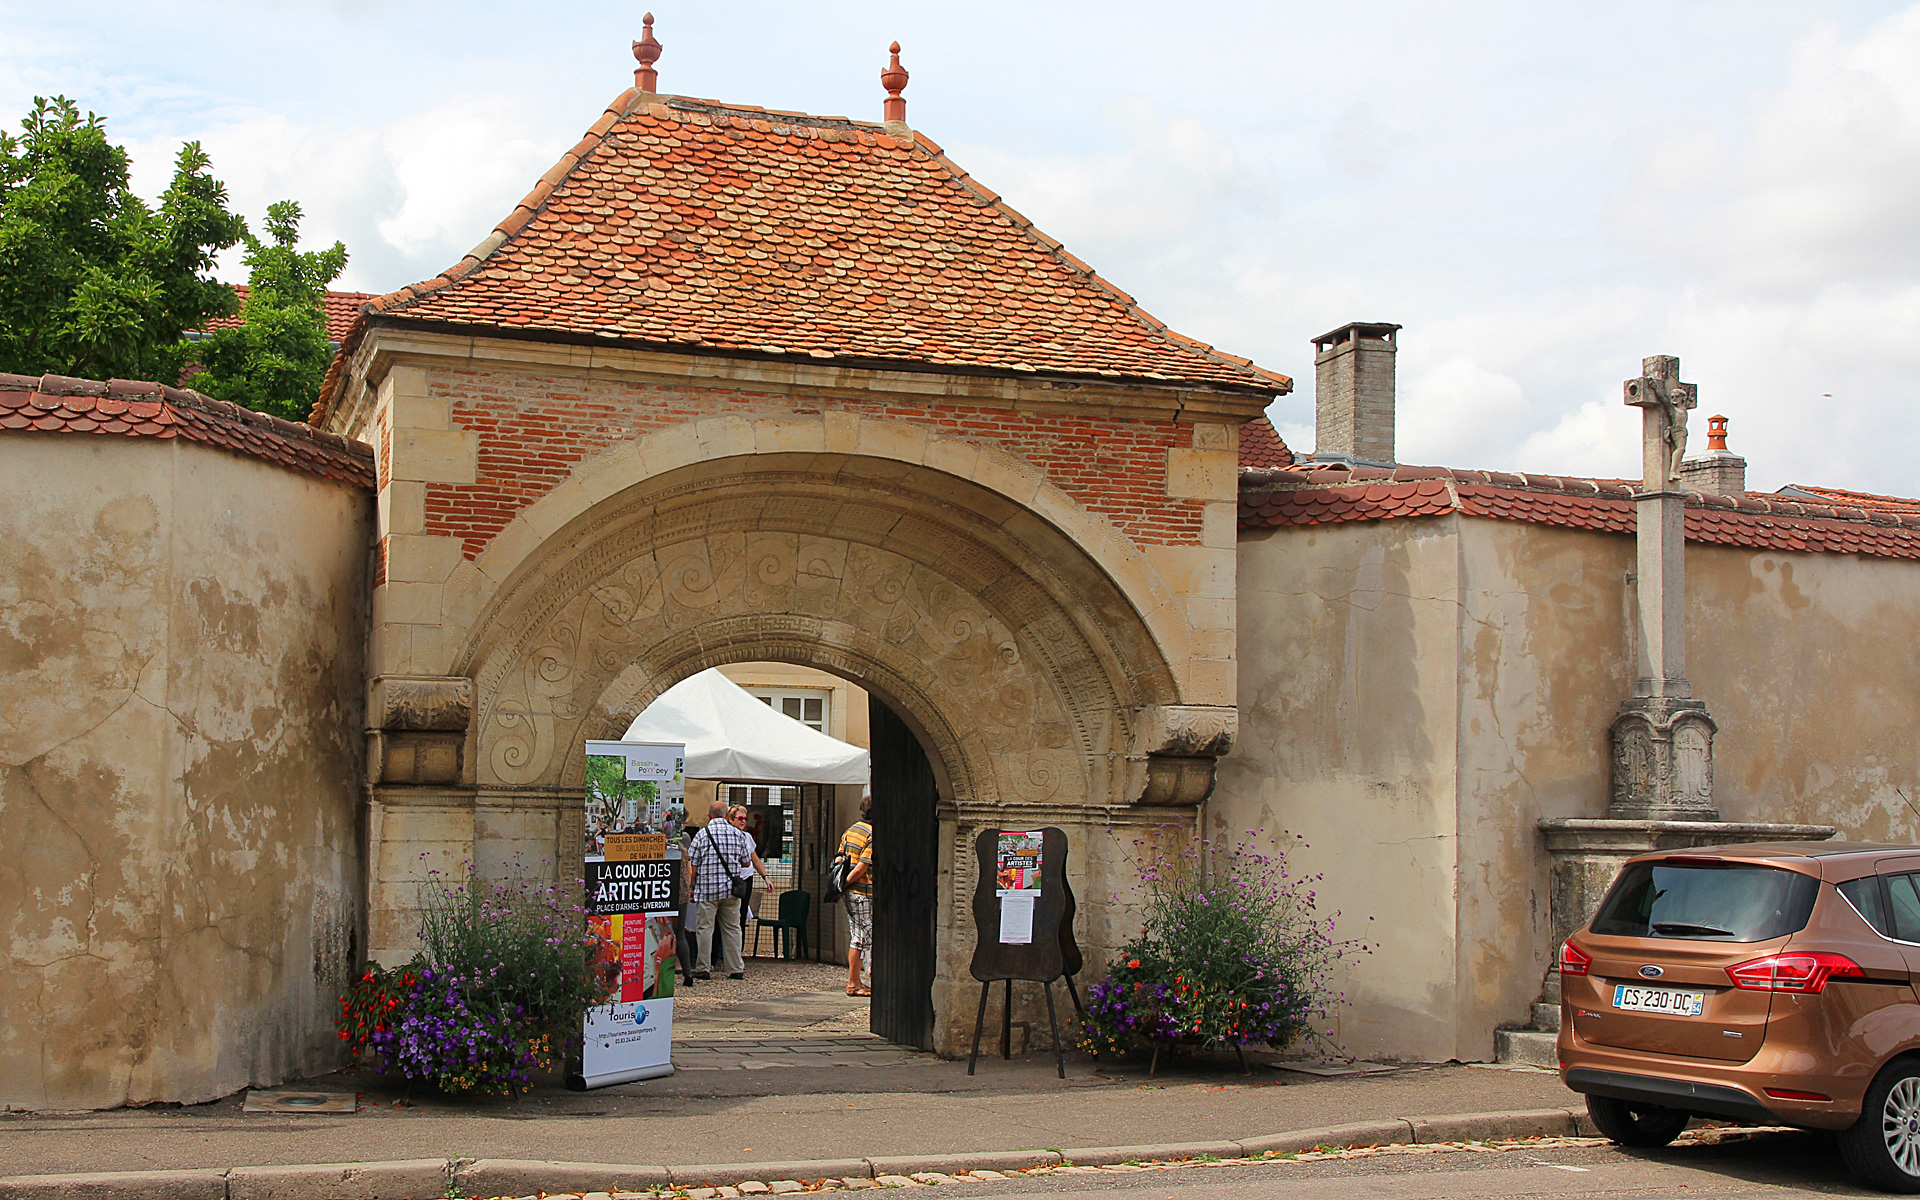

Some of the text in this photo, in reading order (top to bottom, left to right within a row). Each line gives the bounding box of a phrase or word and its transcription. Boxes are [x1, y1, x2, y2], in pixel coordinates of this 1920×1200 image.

[638, 766, 669, 776] Pompey
[598, 863, 671, 880] LA COUR DES
[596, 880, 671, 902] ARTISTES
[596, 904, 614, 912] PLACE
[616, 902, 640, 911] D'ARMES
[643, 901, 670, 910] LIVERDUN
[1624, 989, 1692, 1010] CS-230-DC
[1692, 1004, 1701, 1012] 54
[609, 1009, 650, 1021] Tourisme
